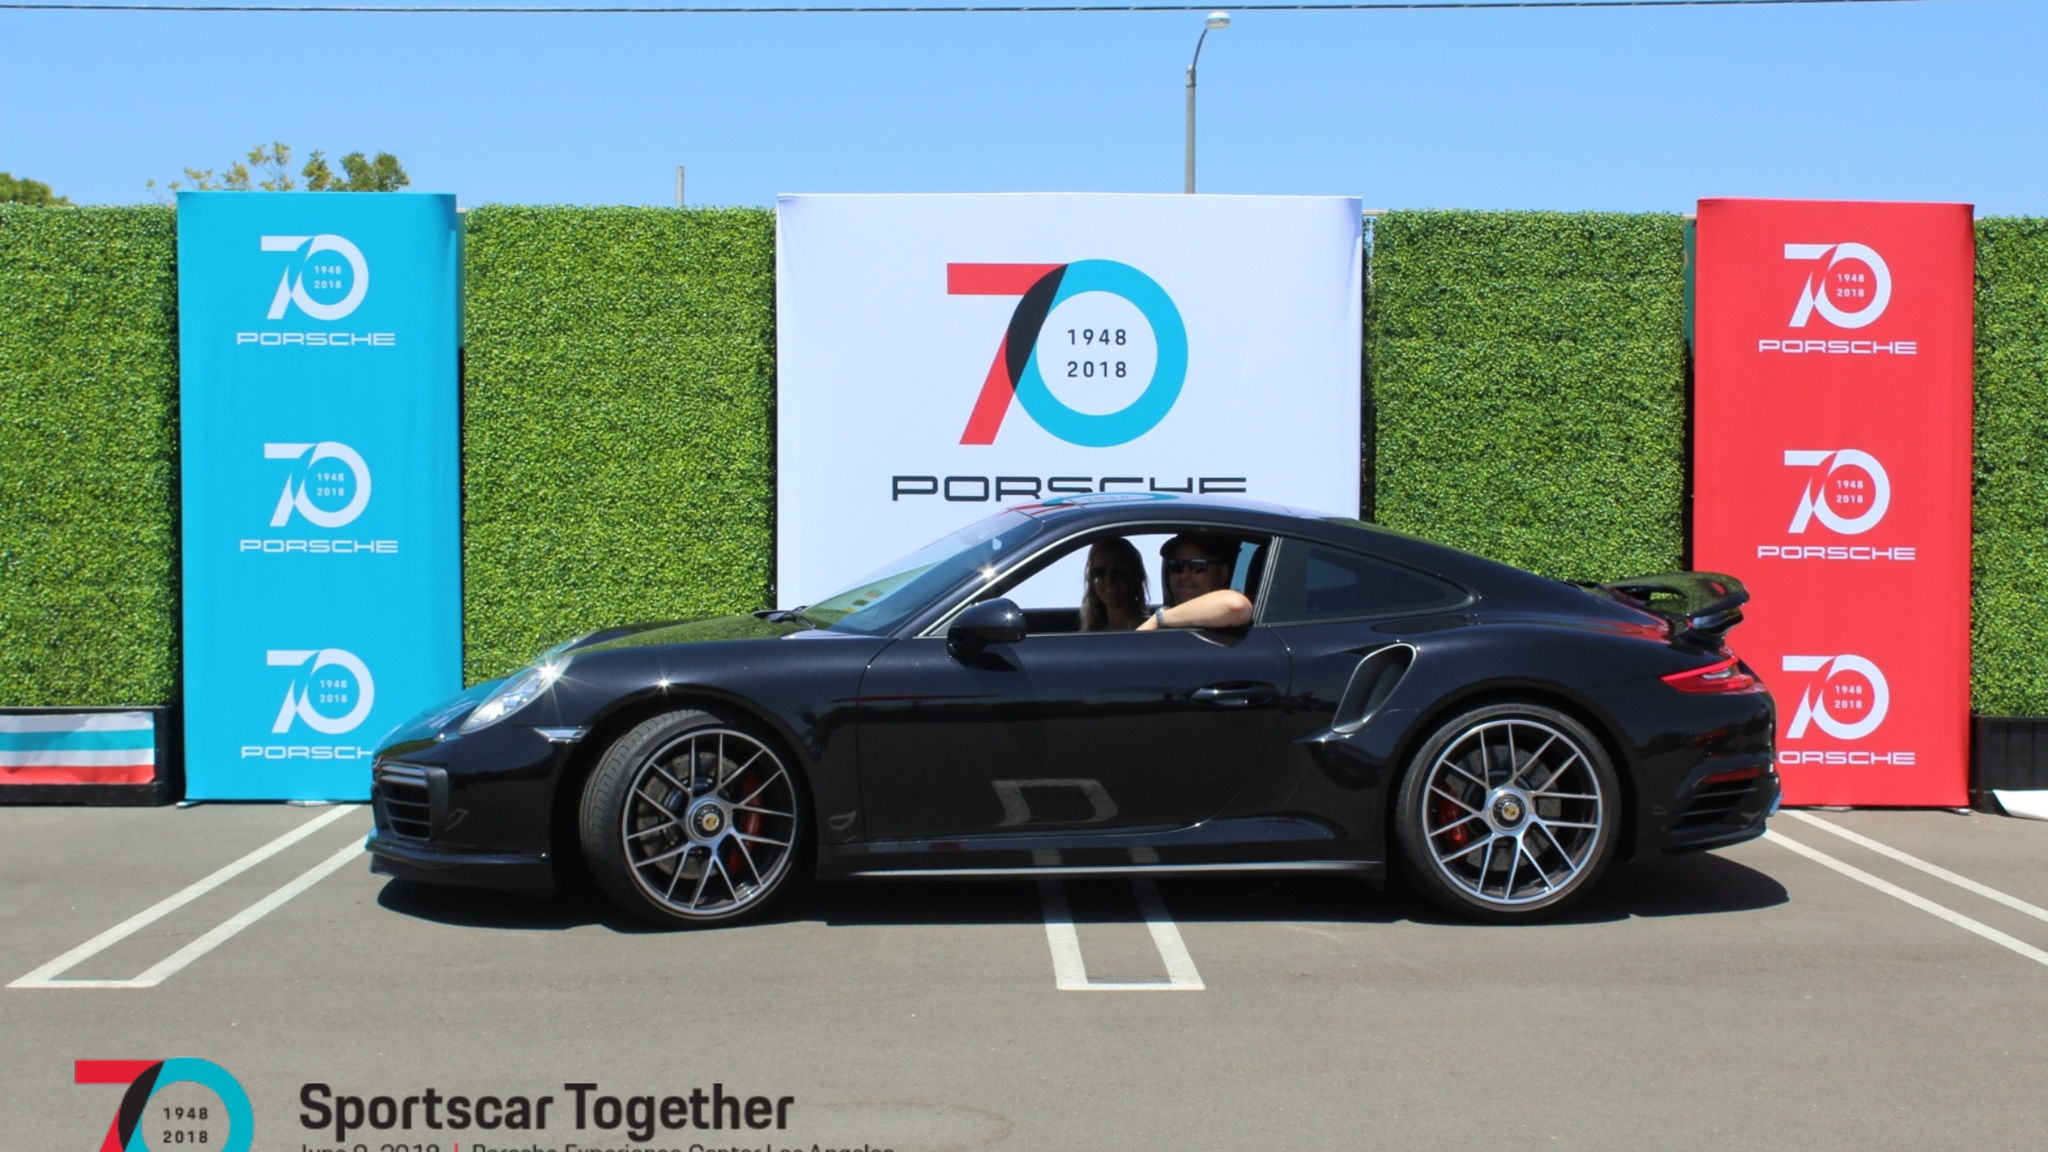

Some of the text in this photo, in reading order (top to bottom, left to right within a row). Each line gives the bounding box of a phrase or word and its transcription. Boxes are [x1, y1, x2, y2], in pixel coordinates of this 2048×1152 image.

[314, 265, 342, 275] 1948
[261, 234, 369, 320] 70
[1837, 273, 1865, 283] 1948
[313, 279, 342, 290] 2018
[1784, 243, 1892, 328] 70
[1836, 288, 1865, 298] 2018
[237, 333, 395, 345] PORSCHE
[1067, 328, 1127, 346] 1948
[947, 259, 1188, 447] 70
[1759, 340, 1916, 354] PORSCHE
[1067, 360, 1127, 378] 2018
[317, 472, 345, 482] 1948
[264, 442, 371, 528] 70
[1836, 479, 1864, 490] 1948
[316, 487, 345, 497] 2018
[1784, 449, 1890, 534] 70
[1836, 494, 1864, 504] 2018
[240, 540, 397, 553] PORSCHE
[1758, 546, 1915, 560] PORSCHE
[319, 679, 348, 689] 1948
[1835, 685, 1863, 695] 1948
[267, 649, 374, 734] 70
[1782, 654, 1889, 740] 70
[319, 693, 348, 704] 2018
[1834, 699, 1863, 709] 2018
[241, 745, 372, 759] PORSCH
[1778, 751, 1915, 765] ORSCHE
